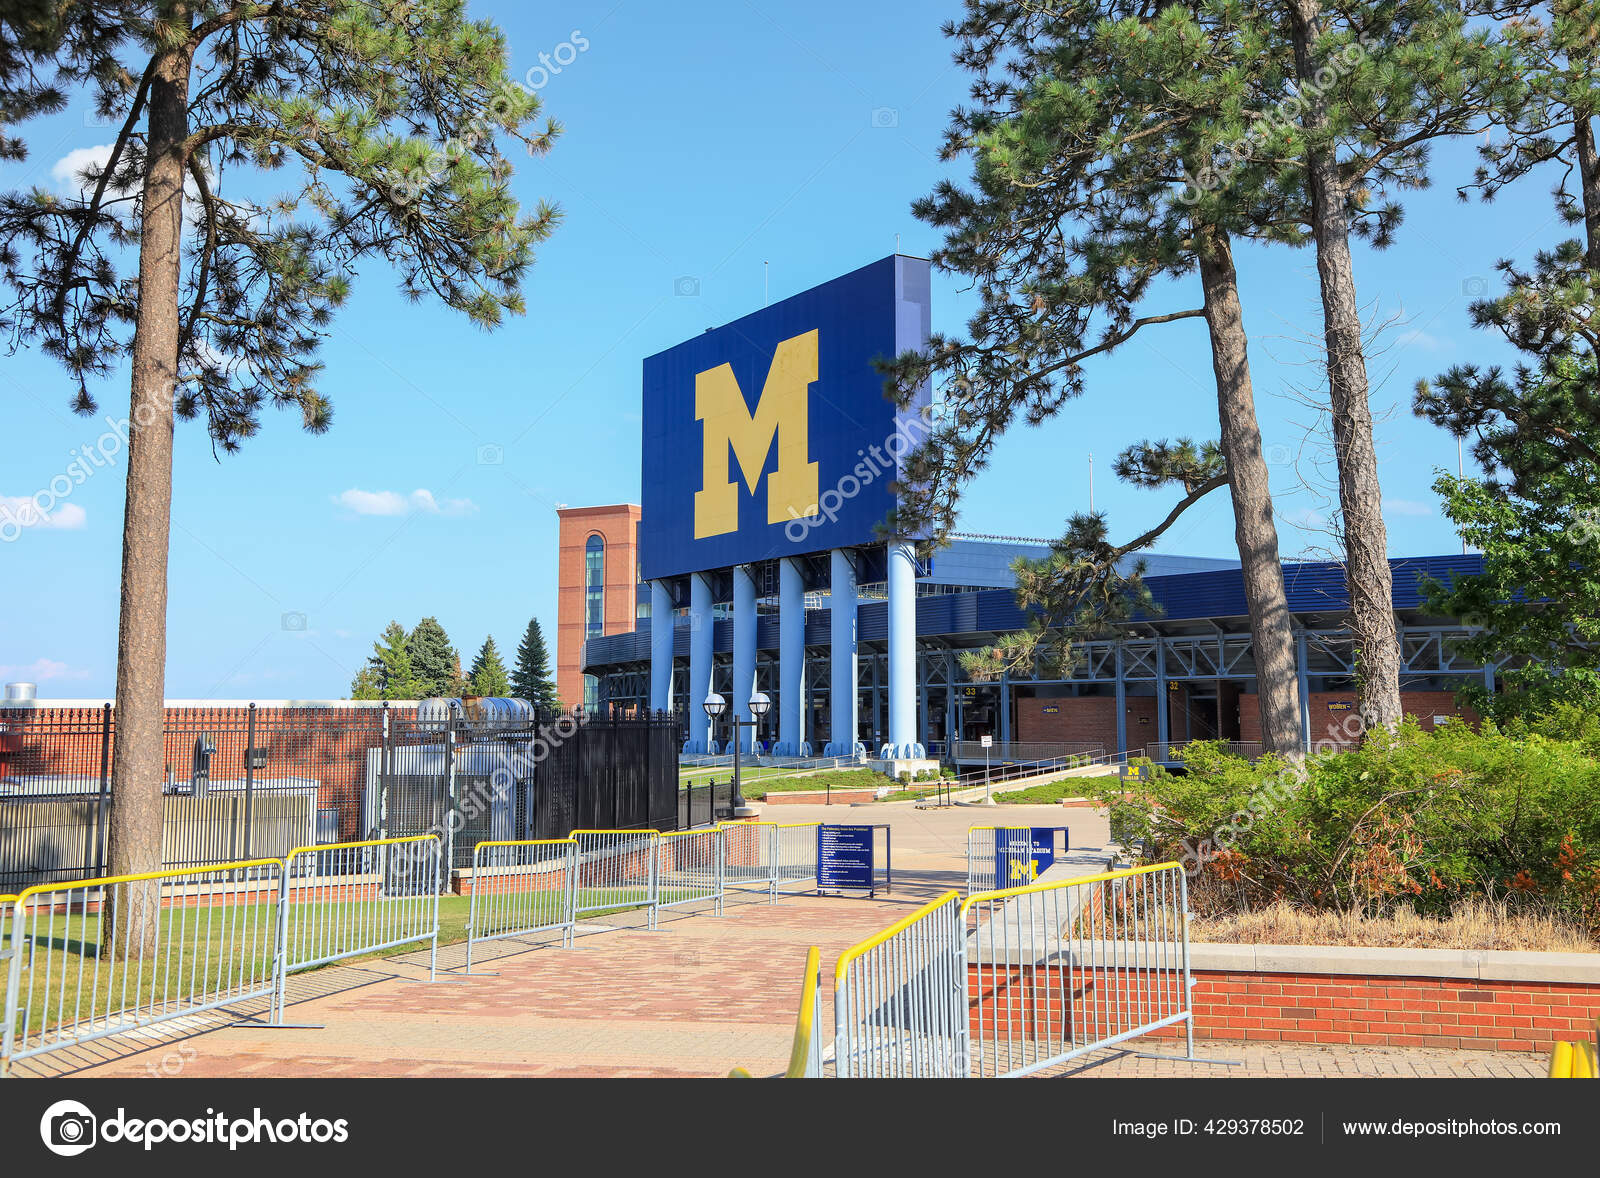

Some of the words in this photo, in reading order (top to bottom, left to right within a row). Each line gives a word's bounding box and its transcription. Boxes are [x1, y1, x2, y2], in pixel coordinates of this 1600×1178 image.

[694, 328, 819, 540] M
[1169, 681, 1179, 690] 32
[965, 687, 976, 696] 33
[1127, 766, 1140, 775] M
